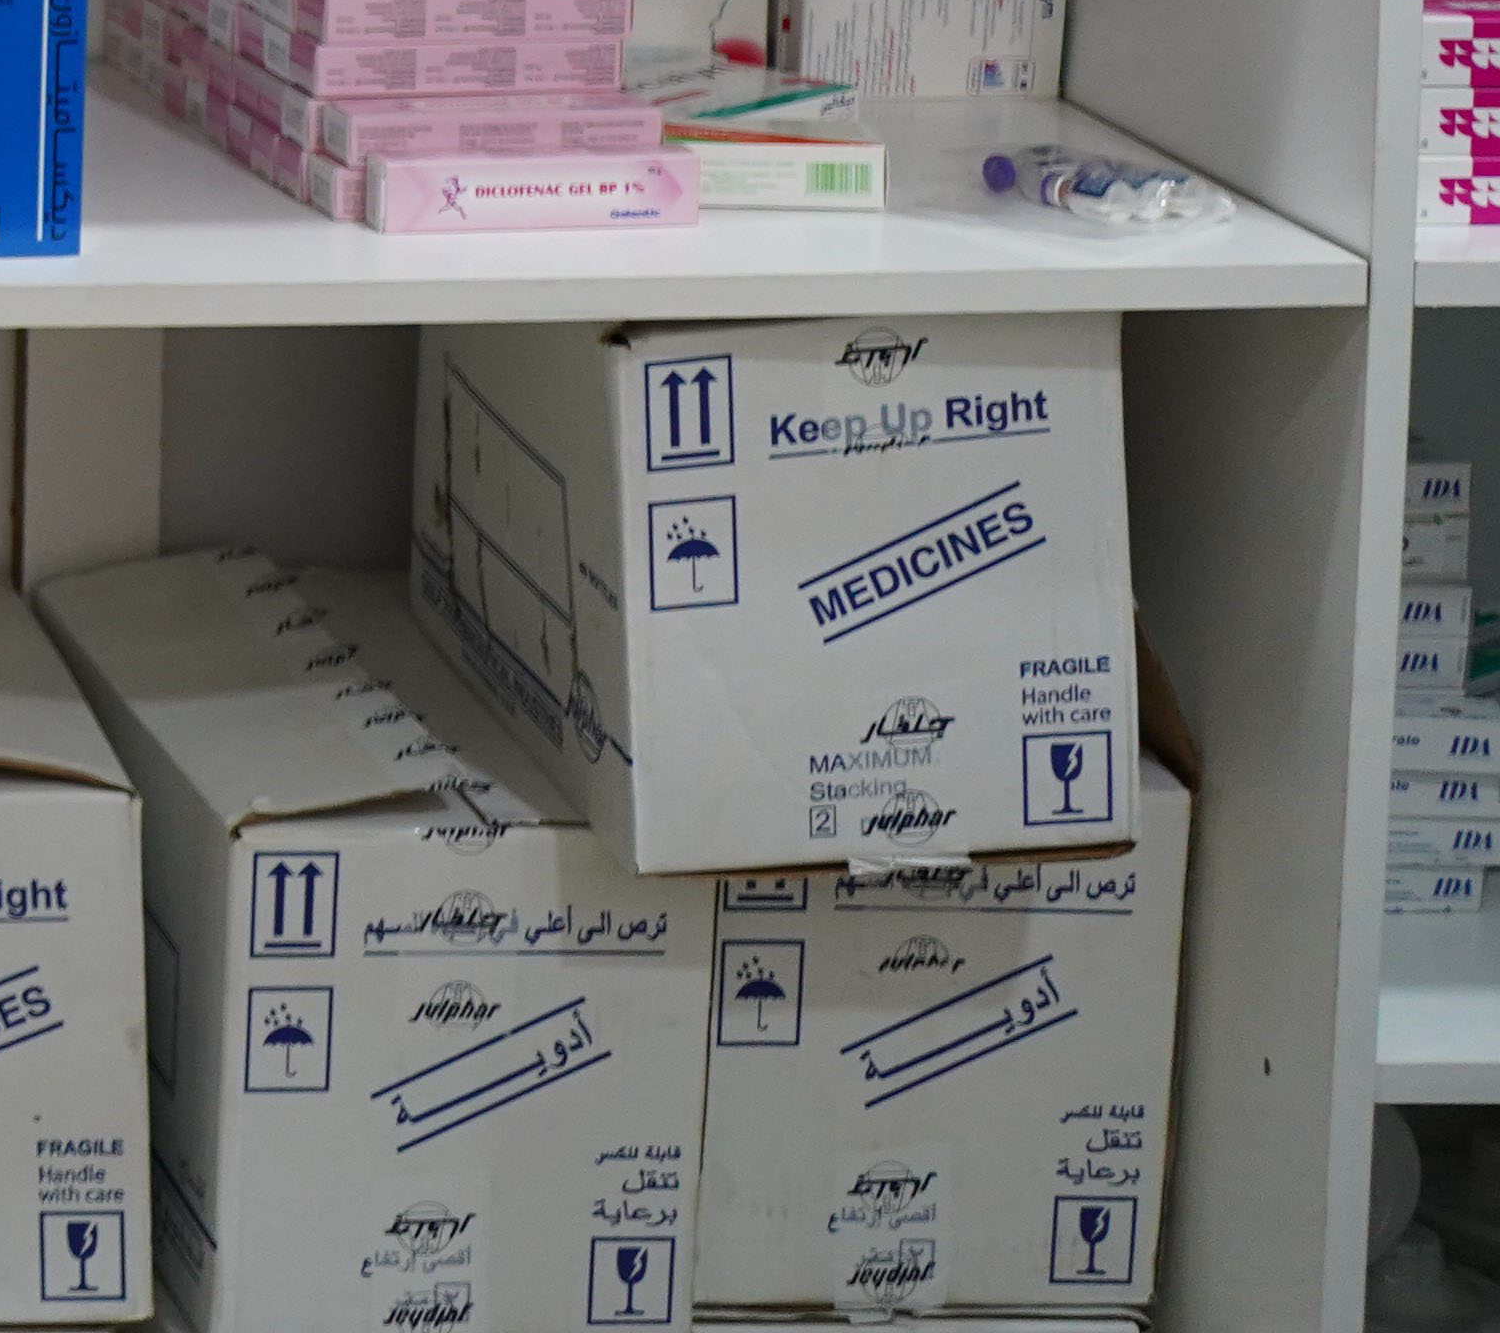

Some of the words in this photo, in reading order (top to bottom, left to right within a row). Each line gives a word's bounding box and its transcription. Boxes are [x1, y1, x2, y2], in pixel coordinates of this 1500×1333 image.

[475, 184, 563, 198] DICLOFENAC
[569, 183, 592, 196] GEL
[600, 183, 617, 195] BP
[769, 407, 868, 449] Keep
[879, 399, 933, 441] Up
[945, 388, 1049, 436] Right
[807, 498, 1036, 629] MEDICINES
[1019, 655, 1111, 678] FRAGILE
[1021, 684, 1092, 706] Handle
[1022, 705, 1068, 726] with
[1074, 706, 1112, 723] care
[814, 811, 832, 832] 2
[35, 1139, 125, 1157] FRAGILE
[37, 1164, 107, 1185] Handle
[37, 1183, 81, 1204] with
[85, 1184, 126, 1203] care
